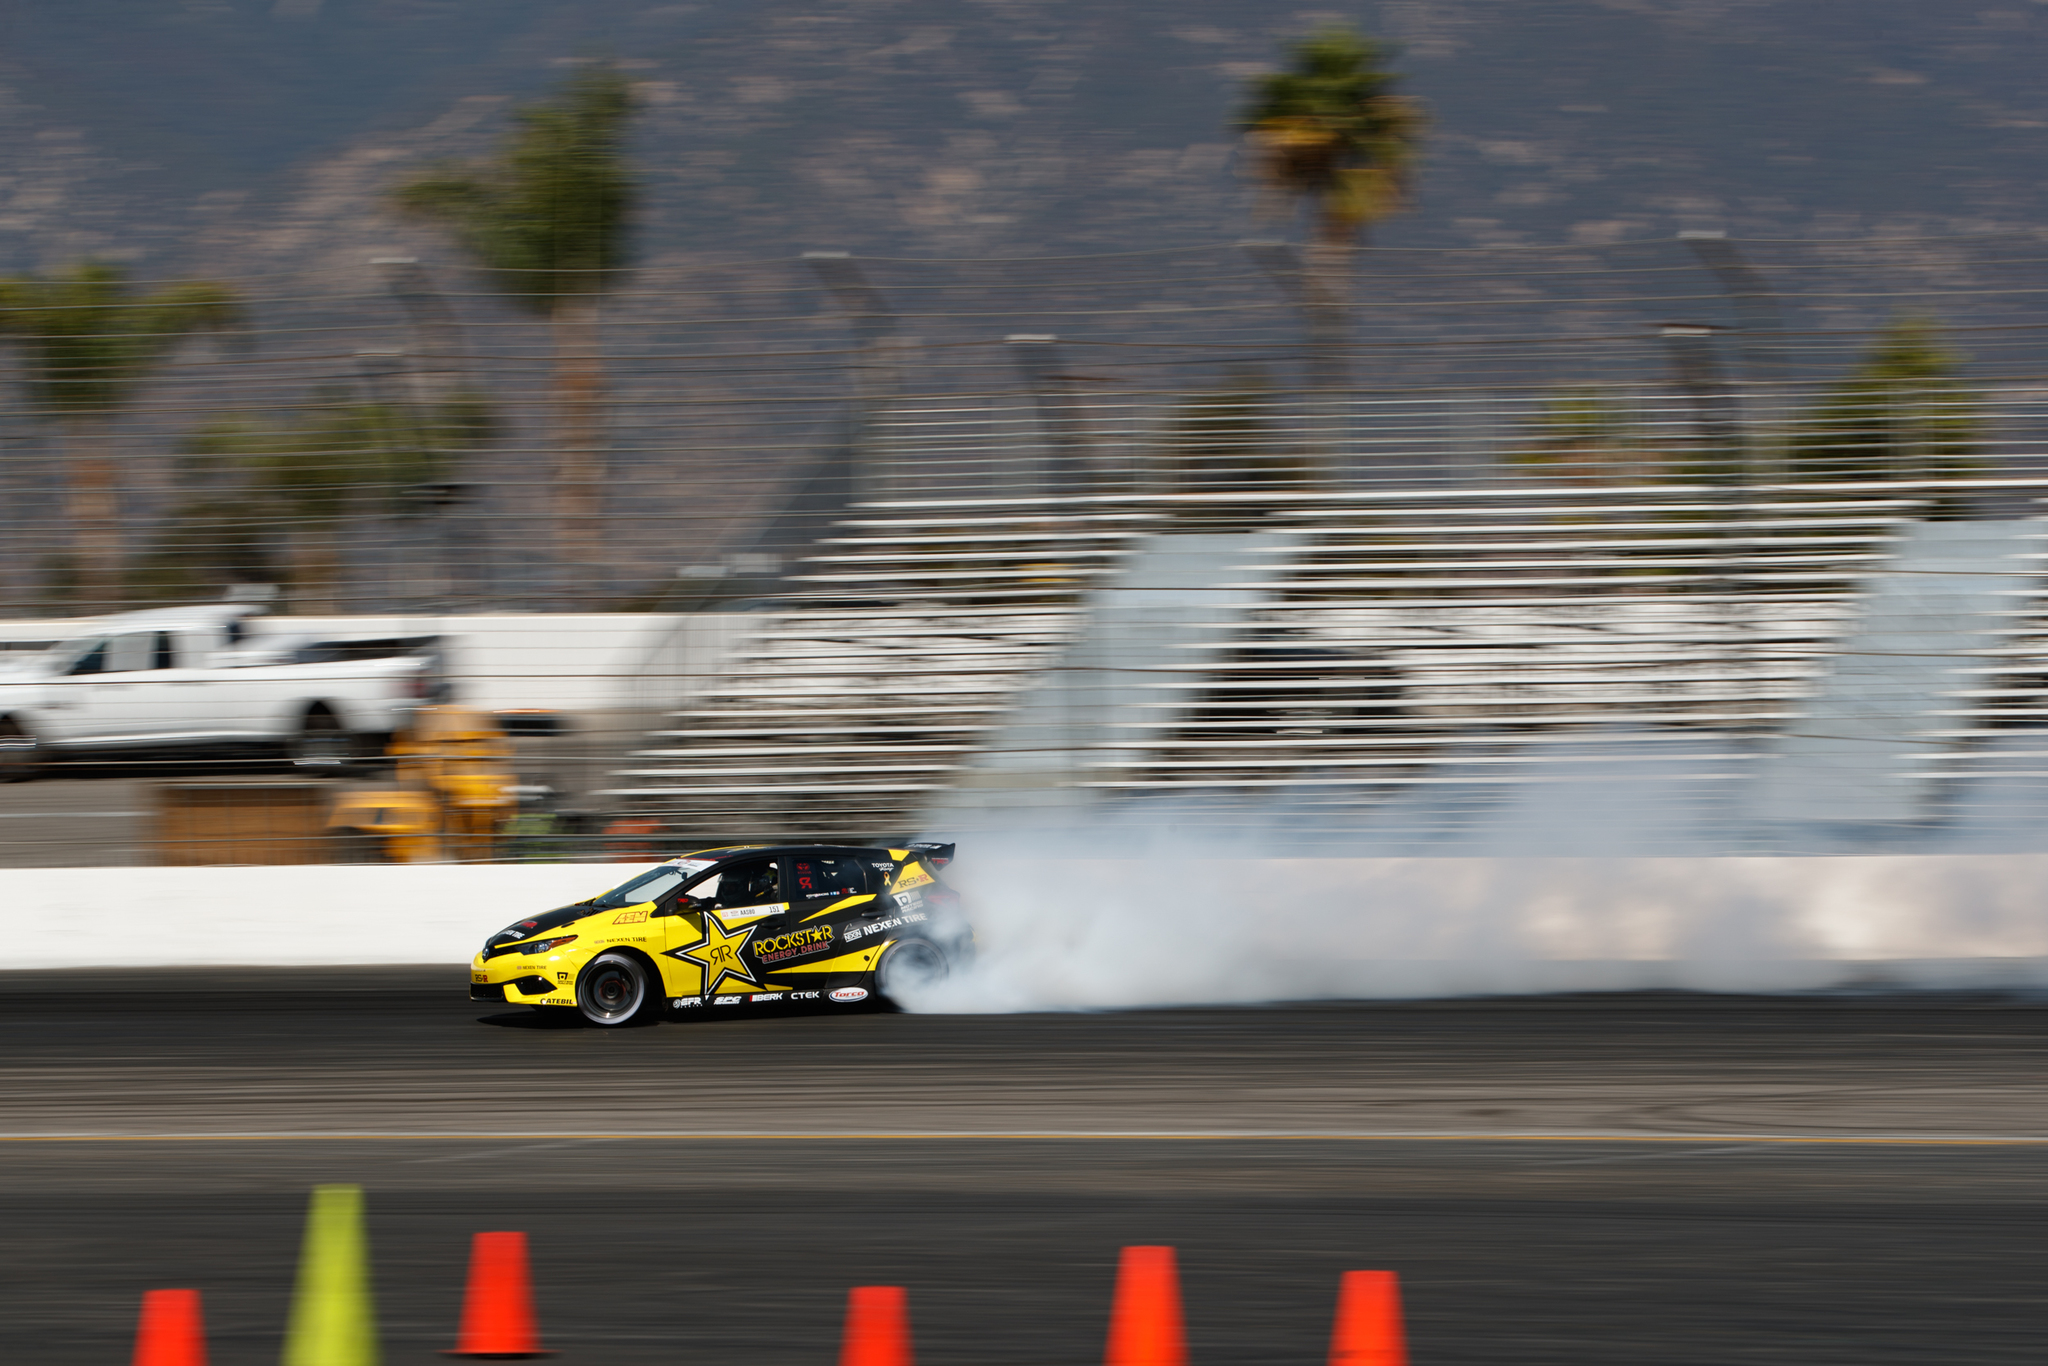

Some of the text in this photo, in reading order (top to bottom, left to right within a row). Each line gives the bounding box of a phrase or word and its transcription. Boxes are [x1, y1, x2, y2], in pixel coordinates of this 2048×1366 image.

[769, 905, 780, 913] 151
[612, 911, 648, 925] AEM
[863, 918, 902, 936] NEXEN
[902, 913, 928, 924] TIRE
[754, 925, 833, 955] ROCKSTAR
[762, 941, 828, 962] ENERGY DRINK
[758, 993, 783, 1001] BERK
[790, 991, 820, 1000] CTEK
